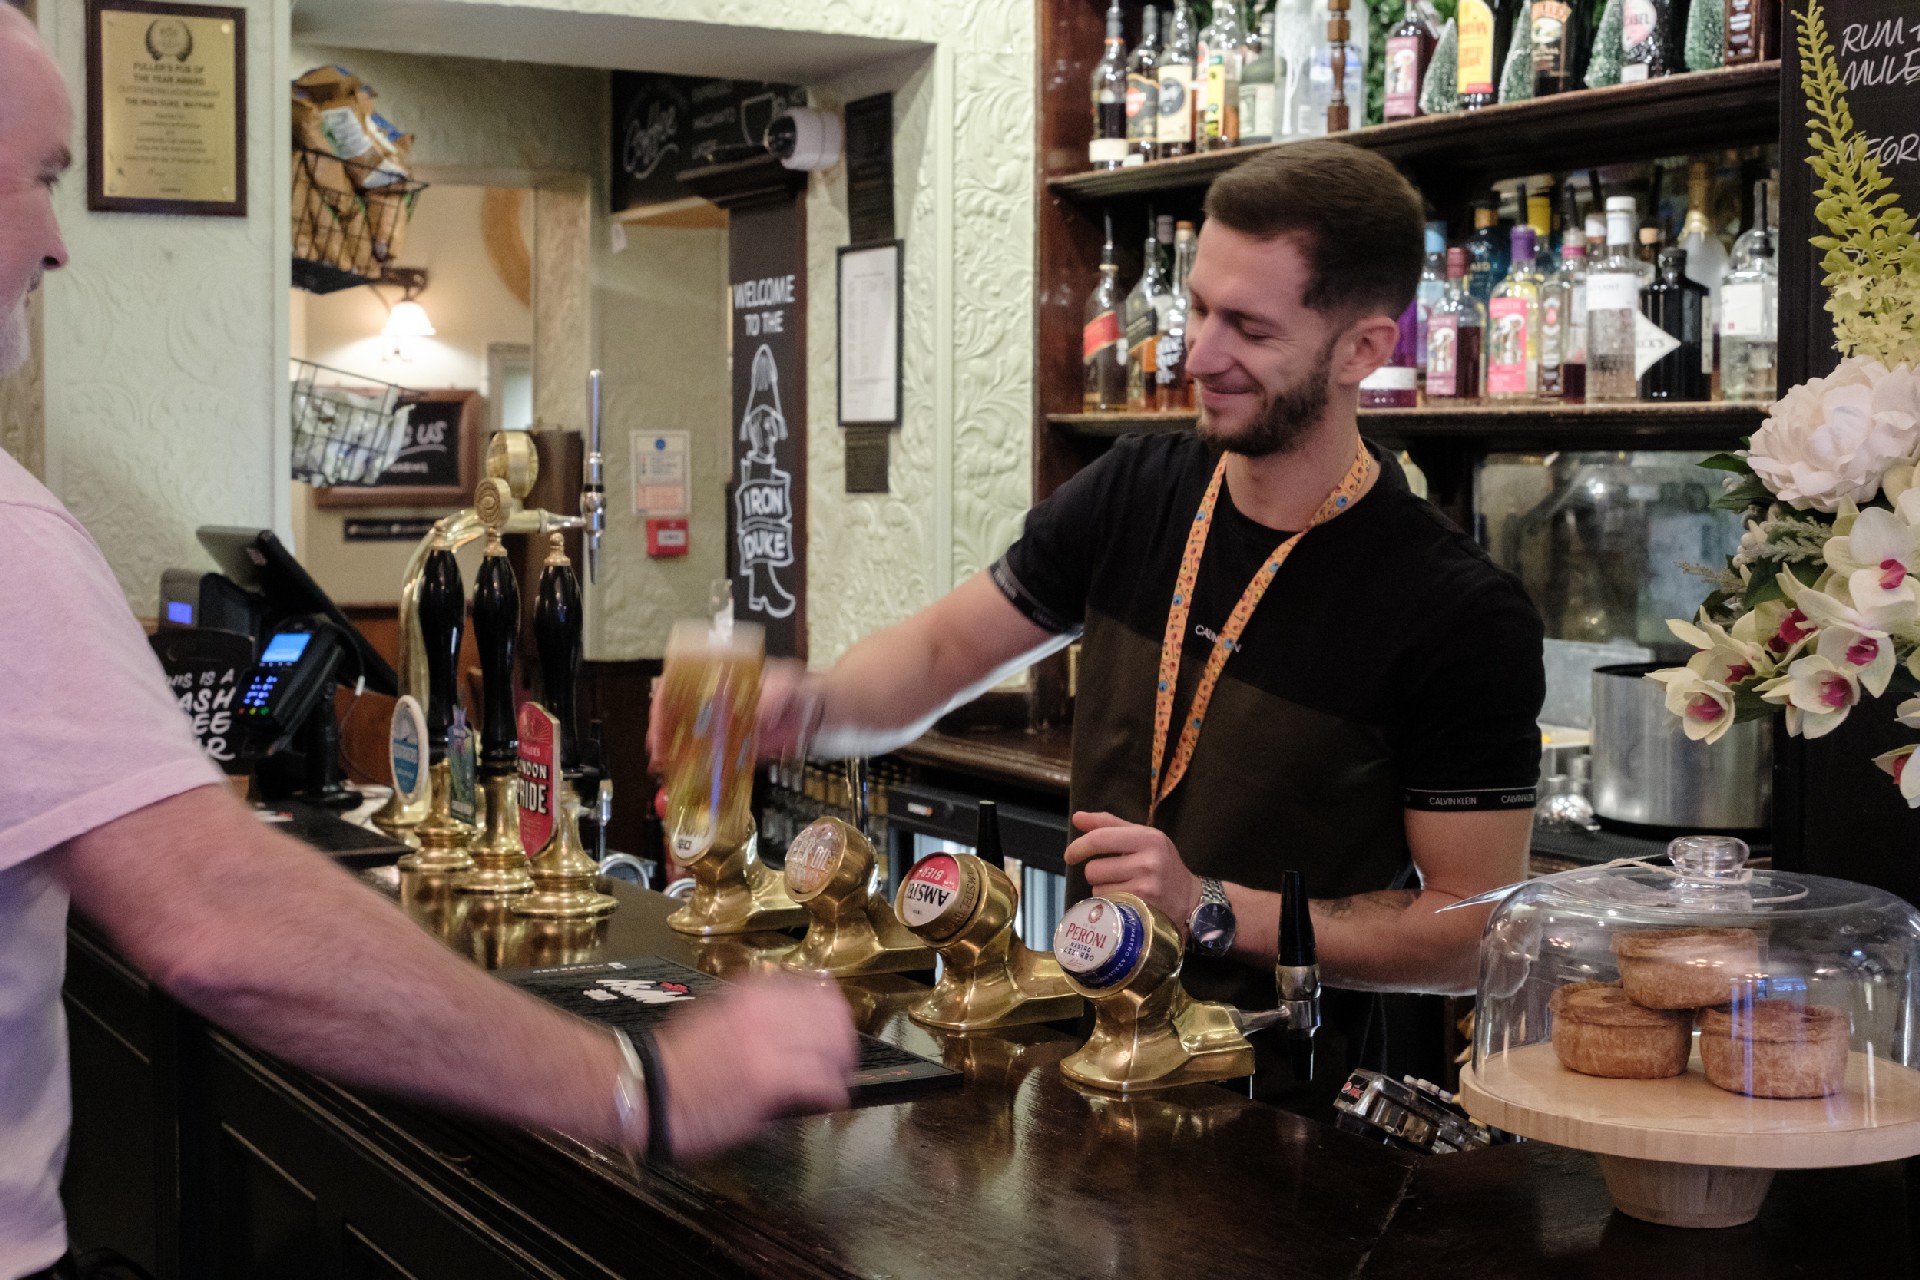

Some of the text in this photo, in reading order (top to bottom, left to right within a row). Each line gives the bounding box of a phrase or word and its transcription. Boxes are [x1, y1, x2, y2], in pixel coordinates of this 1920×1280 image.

[1841, 17, 1904, 56] RUM
[734, 274, 796, 308] WELCOME
[744, 310, 784, 336] TO THE
[744, 486, 783, 516] IRON
[744, 530, 786, 559] DUKE
[199, 670, 216, 686] IS
[219, 668, 235, 685] A
[179, 686, 237, 713] ASH
[192, 711, 232, 736] EE
[1429, 796, 1477, 806] CALVIN KLEIN
[920, 866, 945, 881] BIER
[907, 883, 951, 908] AMSTE
[1065, 922, 1107, 949] PERONI
[1062, 946, 1095, 962] AZZRRO
